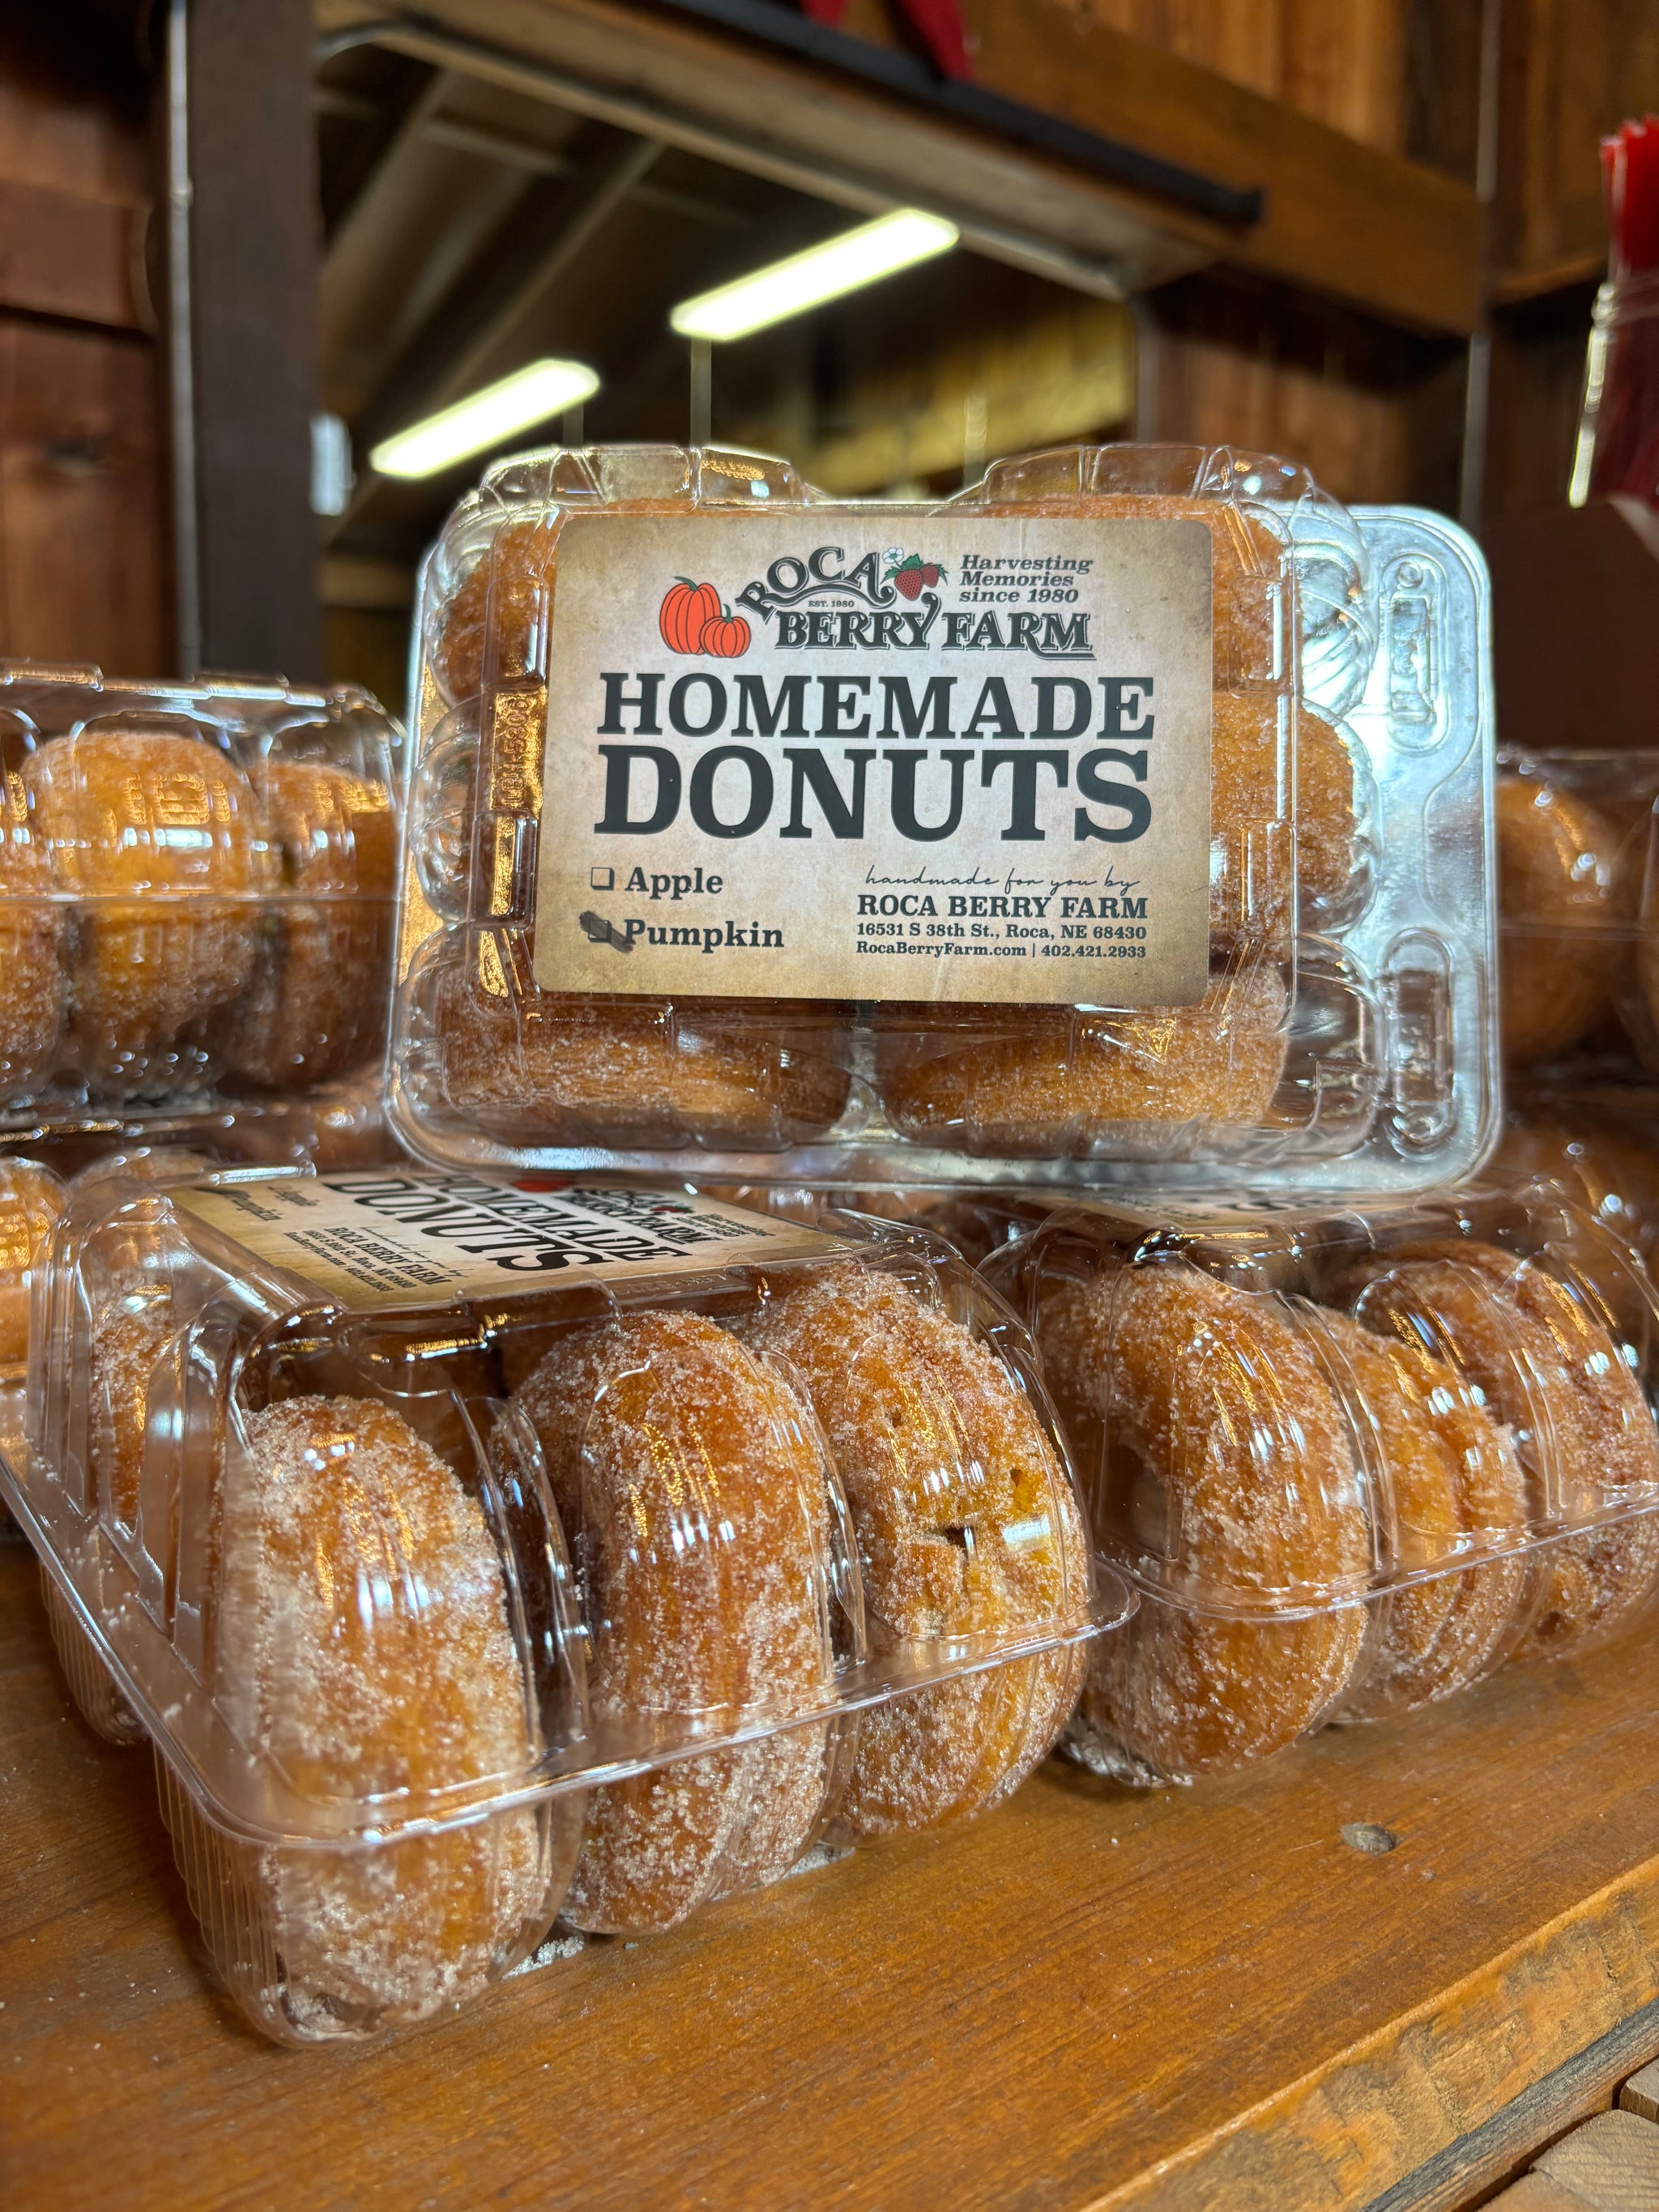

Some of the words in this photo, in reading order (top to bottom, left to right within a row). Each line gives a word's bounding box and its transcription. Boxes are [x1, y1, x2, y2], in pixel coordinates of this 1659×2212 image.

[959, 555, 1093, 574] Harvesting
[960, 571, 1074, 587] Memories
[735, 546, 898, 623] ROCA
[959, 589, 1023, 603] since
[1027, 589, 1079, 603] 1980
[831, 600, 855, 608] 1980
[774, 592, 941, 650] BERRY
[940, 612, 1097, 661] FARM
[597, 672, 1155, 740] HOMEMADE
[593, 744, 1153, 843] DONUTS
[625, 867, 723, 900] Apple
[865, 865, 999, 885] handmade
[1004, 867, 1044, 894] for
[1050, 879, 1097, 897] you
[1104, 866, 1140, 897] by
[857, 894, 938, 917] ROCA
[948, 895, 1051, 918] BERRY
[1060, 897, 1148, 919] FARM
[624, 918, 784, 954] Pumpkin
[857, 923, 904, 936] 16531
[909, 923, 921, 936] S
[926, 923, 966, 937] 38th
[971, 923, 1000, 940] St.,
[1005, 924, 1055, 940] Roca,
[1060, 926, 1087, 940] NE
[1093, 926, 1146, 940] 68430
[855, 941, 1026, 958] RocaBerryFarm.com
[1041, 944, 1146, 958] 402.421.2933
[323, 1179, 614, 1271] DONUTS
[414, 1174, 693, 1261] HOMEMADE
[620, 1216, 723, 1244] FARM
[324, 1227, 369, 1243] ROCA
[354, 1242, 412, 1265] BERRY
[395, 1264, 453, 1285] FARM
[372, 1268, 394, 1276] NE
